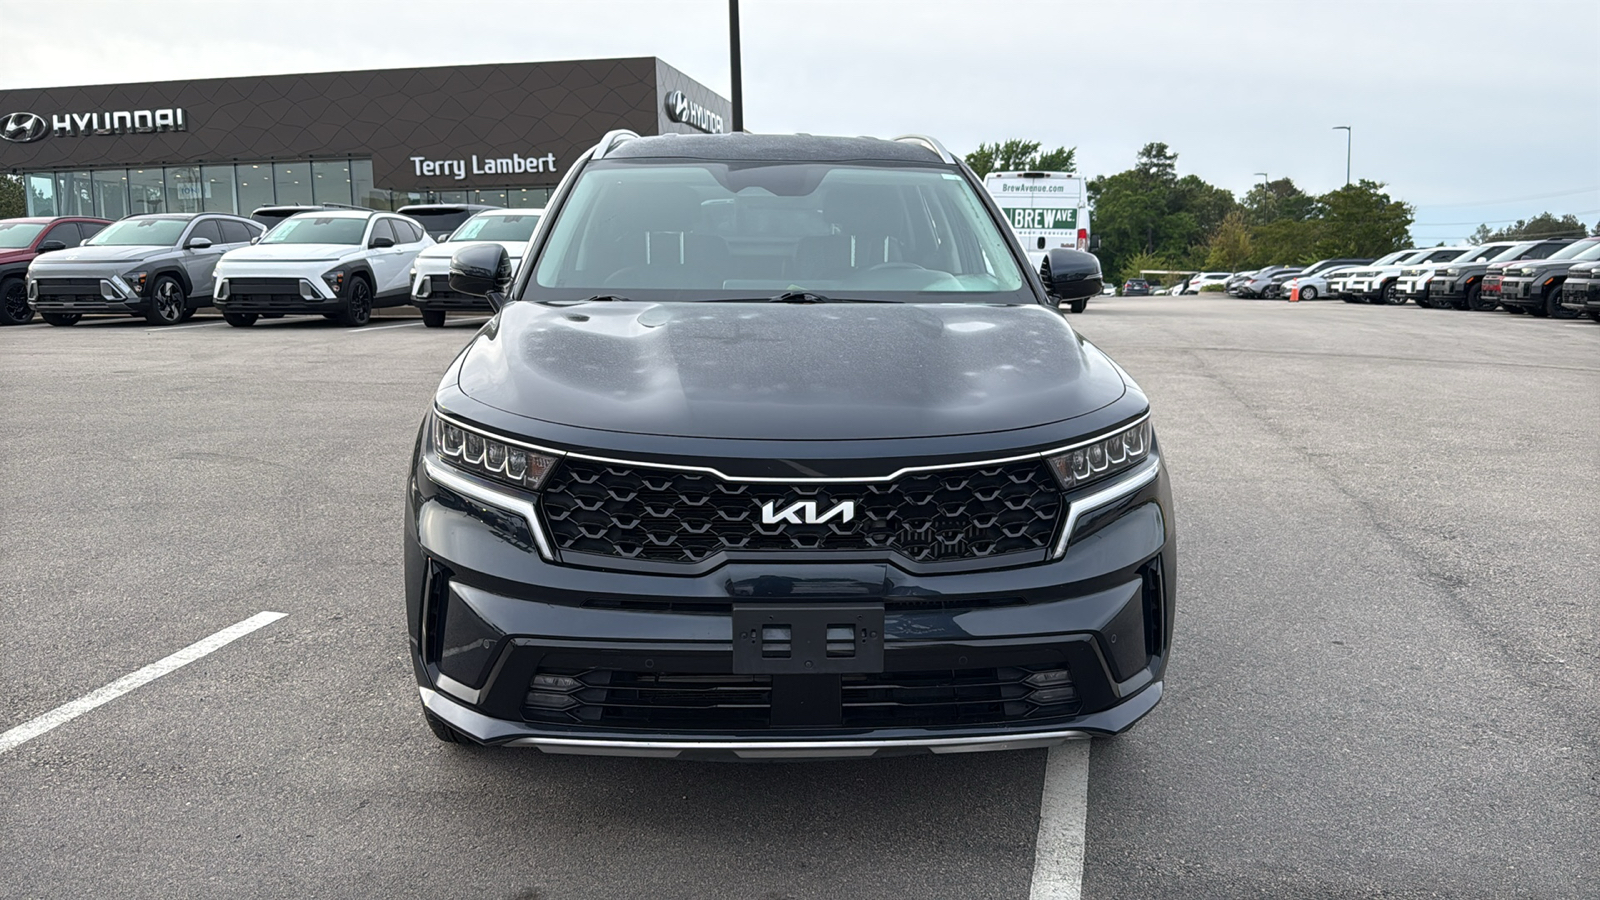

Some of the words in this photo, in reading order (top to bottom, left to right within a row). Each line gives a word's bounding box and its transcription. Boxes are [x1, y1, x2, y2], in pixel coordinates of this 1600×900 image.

[52, 108, 185, 137] HYUNDAI
[690, 101, 723, 134] HYUNDAI
[410, 156, 466, 180] Terry
[472, 152, 557, 174] Lambert
[1003, 184, 1064, 192] BrewAvenue.com
[1014, 209, 1055, 228] BREW
[1055, 210, 1075, 221] AVE.
[762, 501, 854, 524] KIA
